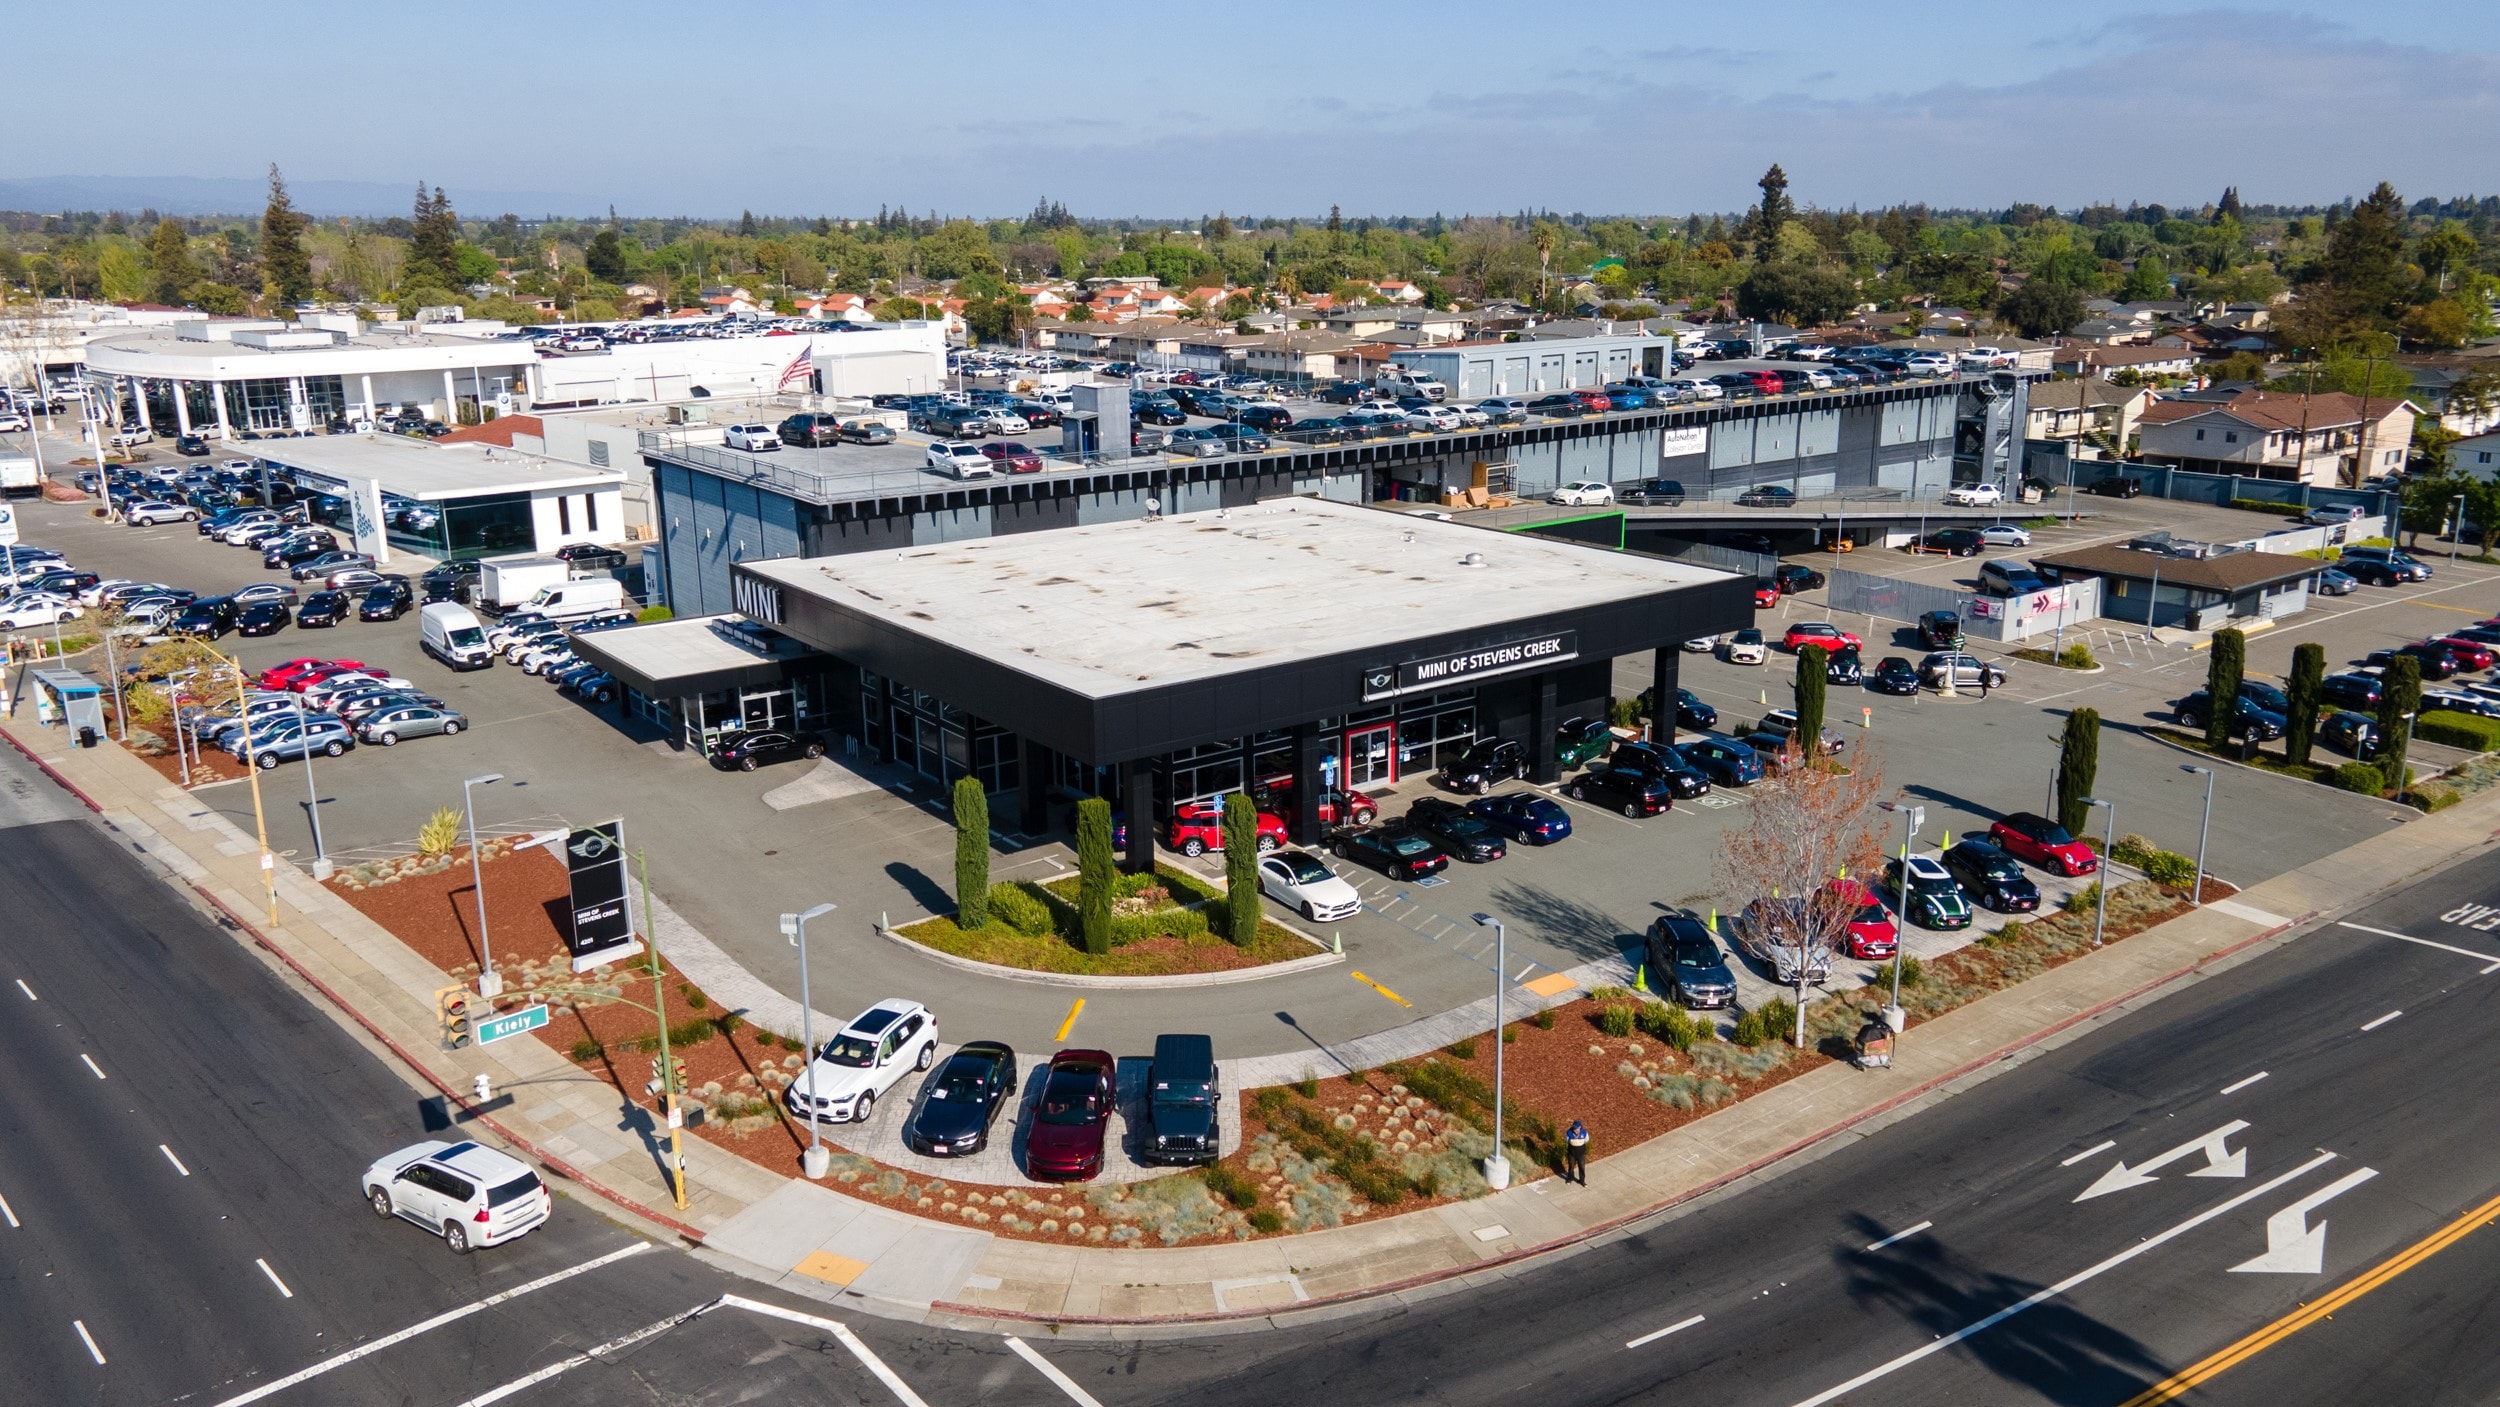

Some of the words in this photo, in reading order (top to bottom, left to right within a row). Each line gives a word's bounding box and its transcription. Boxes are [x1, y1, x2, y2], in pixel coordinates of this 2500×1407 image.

[1667, 434, 1698, 442] AutoNation
[735, 575, 781, 626] MINI
[1418, 661, 1447, 680] MINI
[1450, 657, 1468, 673] OF
[1470, 645, 1522, 669] STEVENS
[1524, 638, 1561, 659] CREEK
[578, 914, 602, 924] STEVENS
[602, 908, 620, 918] CREEK
[495, 1016, 531, 1035] Kiely
